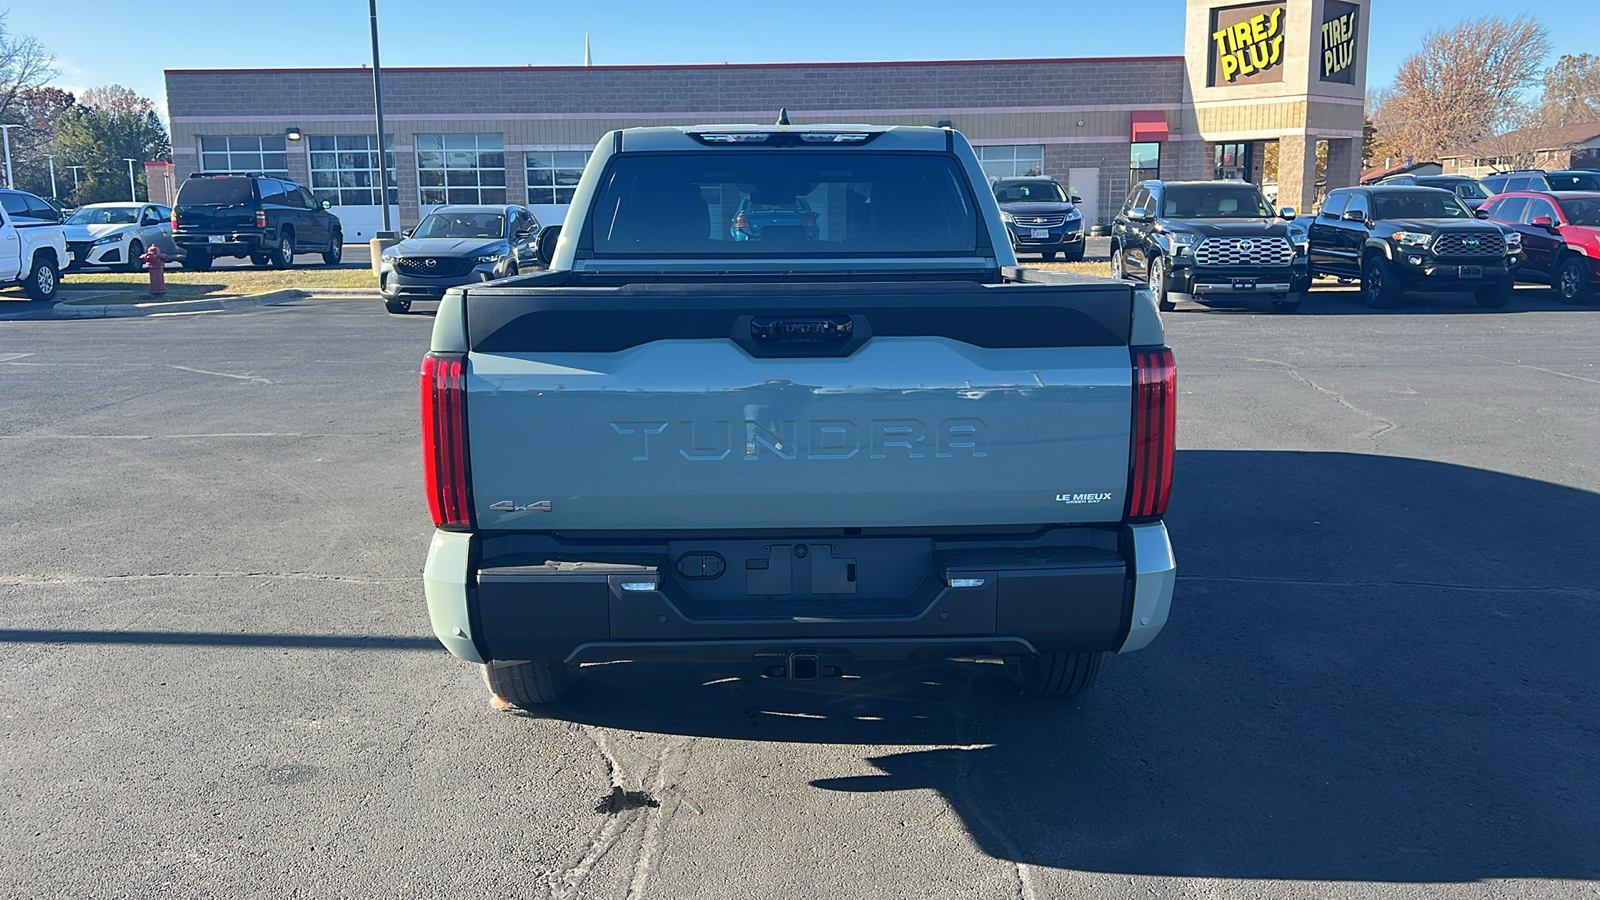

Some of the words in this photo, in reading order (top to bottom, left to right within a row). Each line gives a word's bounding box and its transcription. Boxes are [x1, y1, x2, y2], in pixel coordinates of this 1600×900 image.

[1212, 7, 1281, 55] TIRES
[1322, 11, 1355, 50] TIRES
[1220, 34, 1283, 82] PLUS
[1324, 38, 1354, 77] PLUS
[779, 322, 827, 333] TOYOTA
[610, 417, 989, 461] TUNDRA
[1073, 492, 1112, 501] MIEUX
